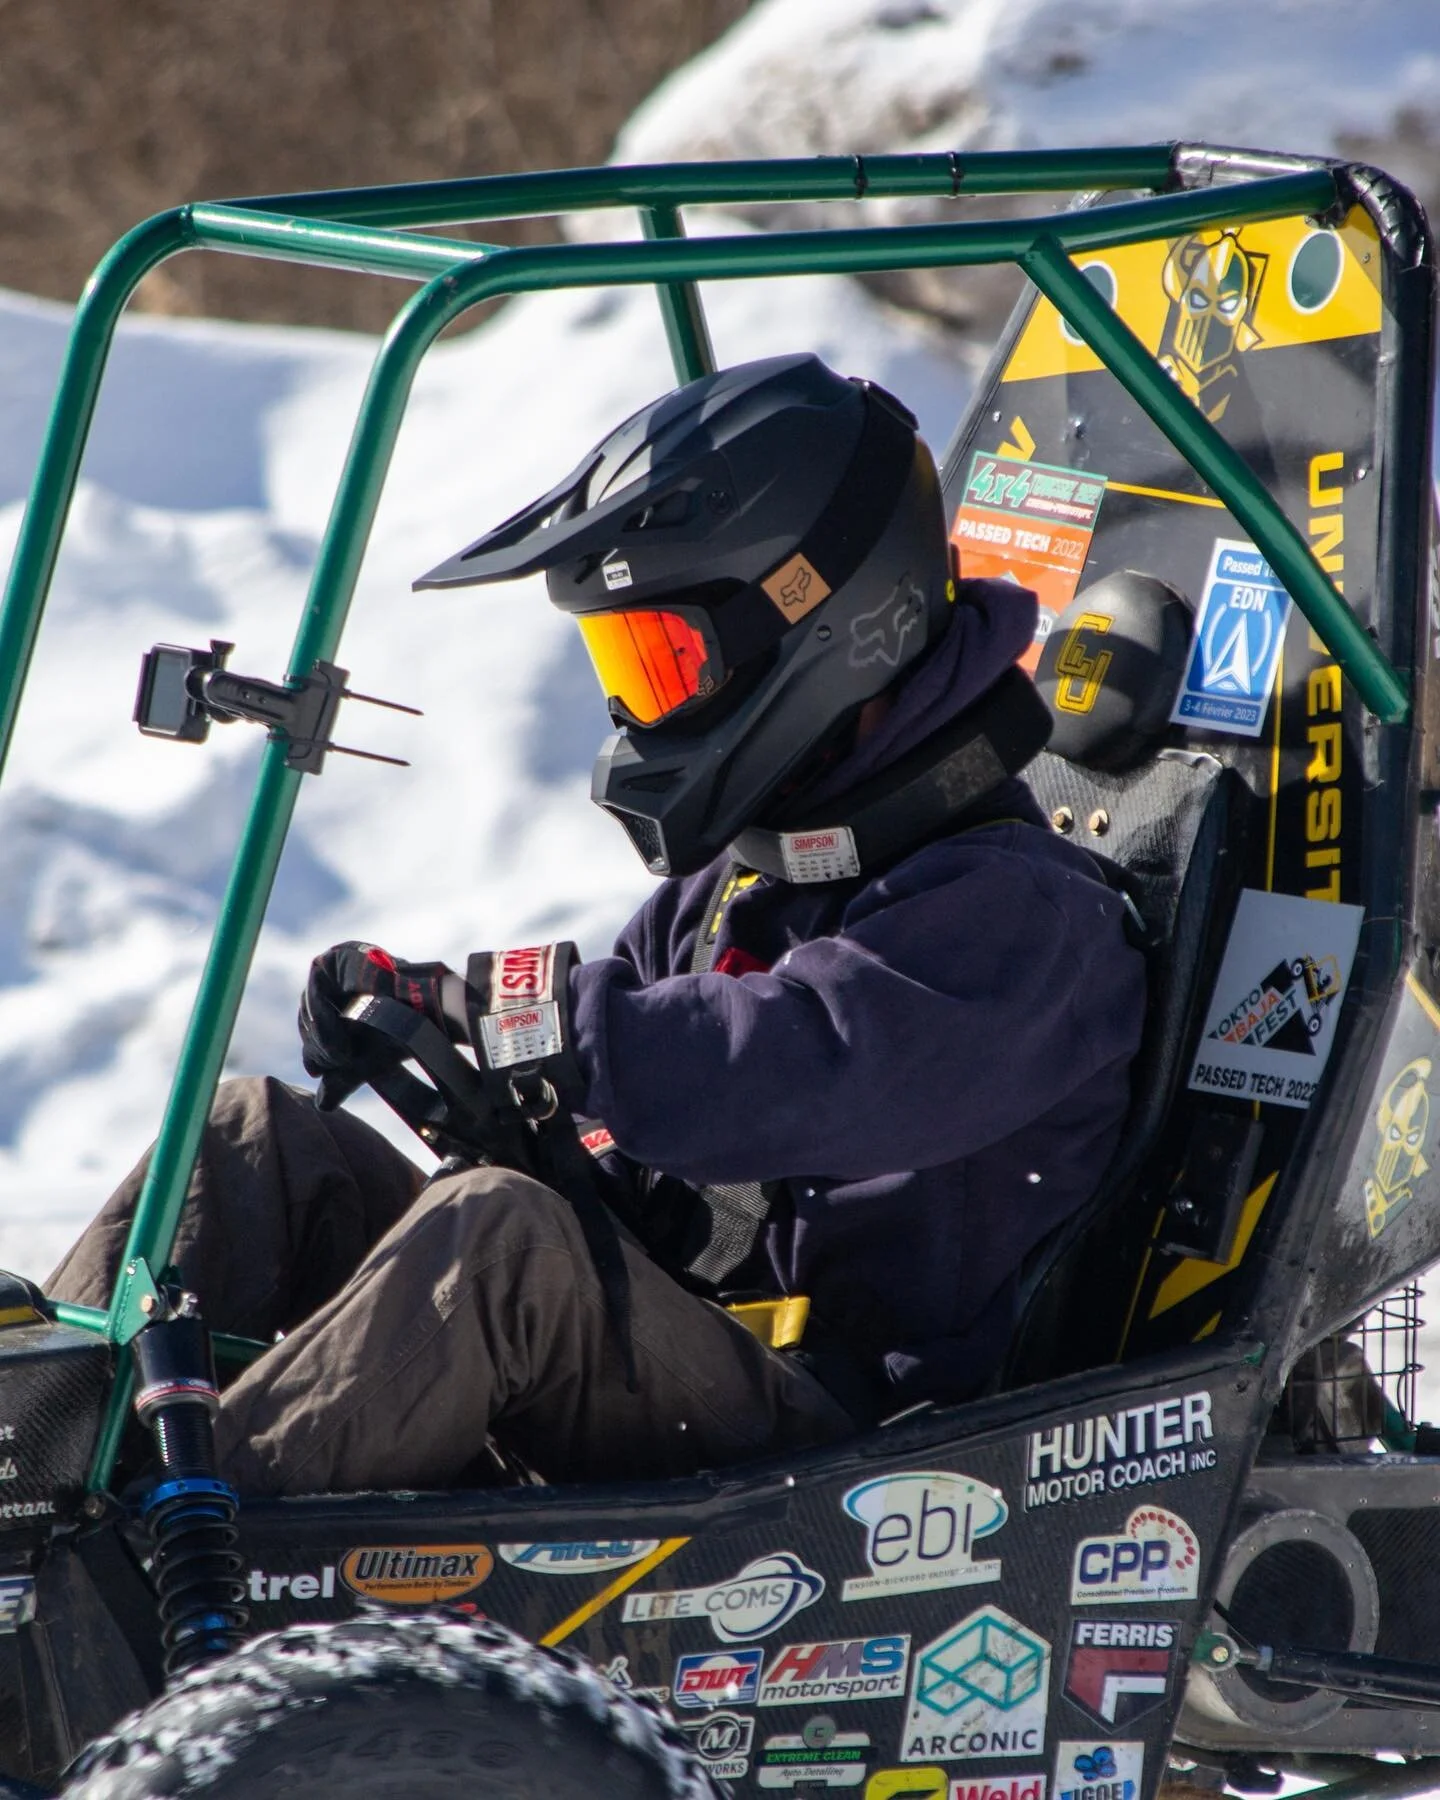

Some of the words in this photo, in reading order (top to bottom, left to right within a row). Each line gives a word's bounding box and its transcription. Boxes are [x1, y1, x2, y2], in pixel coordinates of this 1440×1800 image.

[957, 519, 1012, 545] PASSED
[1014, 529, 1051, 553] TECH
[1051, 537, 1085, 560] 2022
[1223, 556, 1261, 577] Passed
[1229, 586, 1267, 612] EDN
[1306, 452, 1344, 904] UNERSIT
[1233, 707, 1257, 722] 2023
[794, 834, 834, 851] SIMPSON
[499, 1012, 539, 1031] SIMPSON
[1218, 988, 1262, 1036] OKTO
[1253, 989, 1300, 1044] FEST
[1193, 1063, 1247, 1091] PASSED
[1249, 1073, 1285, 1097] TECH
[1030, 1390, 1214, 1479] HUNTER
[1028, 1470, 1105, 1508] MOTOR
[1109, 1450, 1186, 1489] COACH
[871, 1484, 975, 1568] ebi
[354, 1550, 481, 1580] Ultimax
[928, 1567, 980, 1580] INDUSTIES,
[1079, 1539, 1172, 1585] CPP
[247, 1566, 336, 1602] trel
[630, 1594, 693, 1618] LITE
[705, 1583, 785, 1612] COMS
[1076, 1622, 1174, 1649] FERRIS
[765, 1637, 906, 1683] HMS
[763, 1674, 901, 1701] motorsport
[702, 1727, 738, 1750] M
[907, 1729, 1038, 1757] ARCONIC
[767, 1751, 821, 1764] EXTREME
[823, 1750, 861, 1761] CLEAN
[956, 1780, 1042, 1800] Weld
